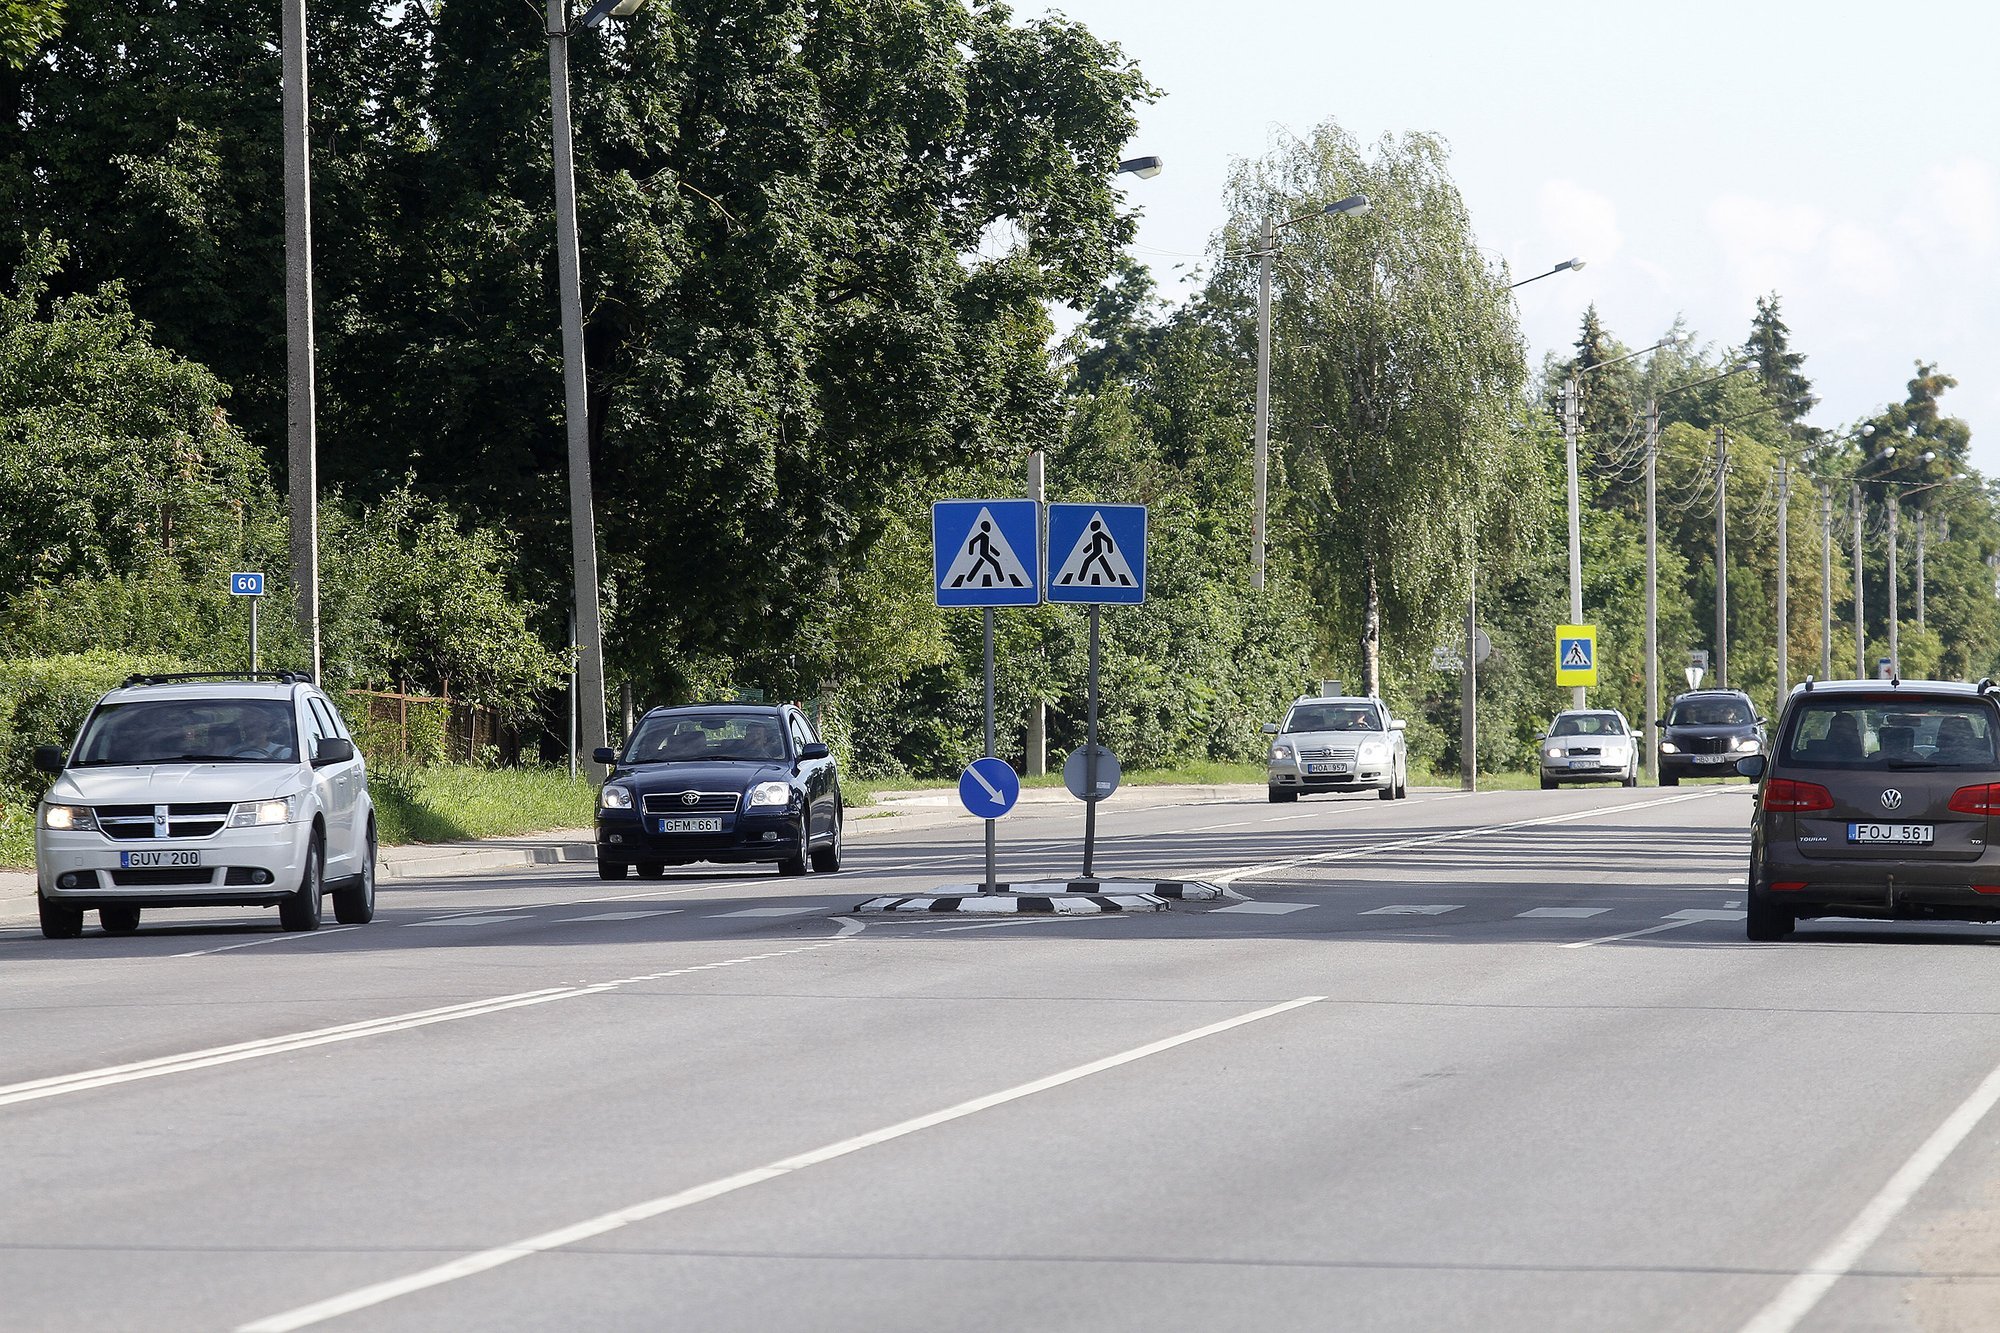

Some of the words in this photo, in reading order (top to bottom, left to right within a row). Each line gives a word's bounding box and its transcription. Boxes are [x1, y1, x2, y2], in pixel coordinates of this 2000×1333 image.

[238, 577, 257, 591] 60
[666, 820, 691, 831] GFM
[698, 820, 719, 831] 661
[1857, 825, 1892, 839] FOJ
[1902, 826, 1929, 840] 561
[130, 853, 161, 866] GUV
[171, 852, 199, 865] 200
